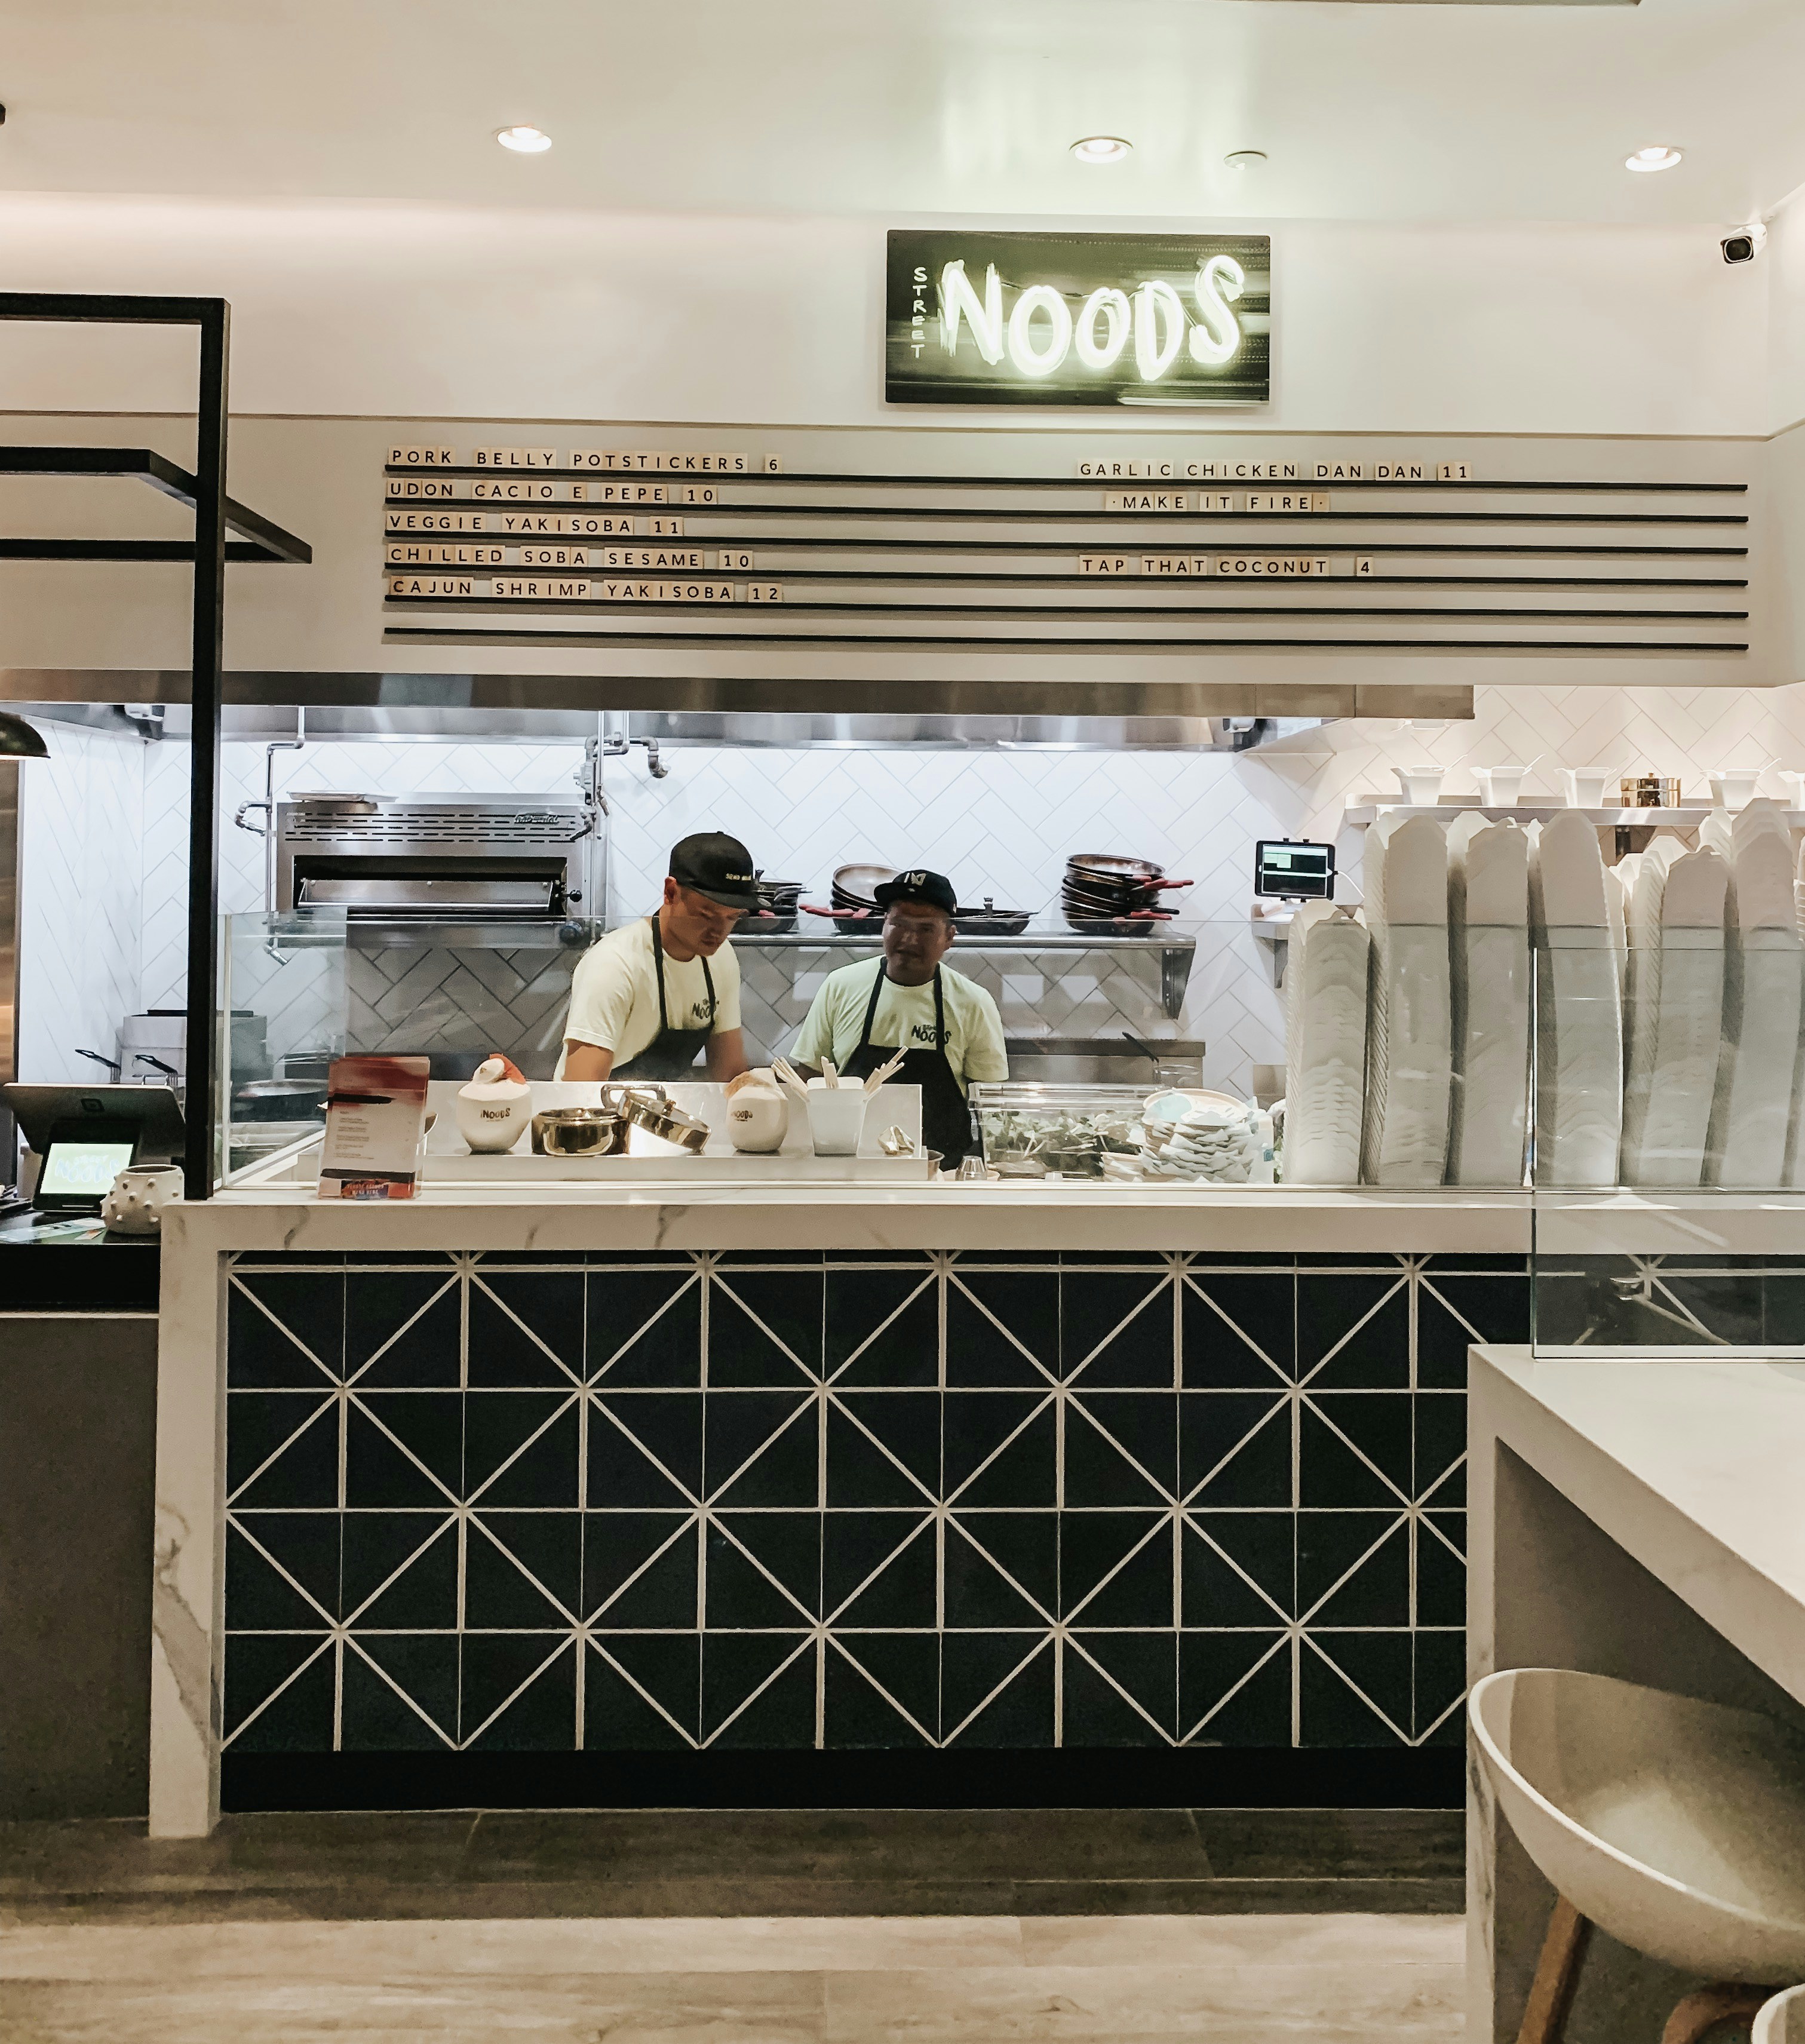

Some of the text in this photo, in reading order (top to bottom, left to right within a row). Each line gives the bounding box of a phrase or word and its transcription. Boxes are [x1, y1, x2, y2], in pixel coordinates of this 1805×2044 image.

[910, 266, 928, 358] STREET
[937, 256, 1244, 380] NOODS
[392, 450, 777, 471] PORK BELLY POTSTICKERS 6
[1080, 464, 1466, 478] GARLIC CHICKEN DAN DAN 11
[391, 482, 713, 502] UDON CACIO E PEPE 10
[1206, 496, 1230, 509] IT
[389, 515, 678, 534] VEGGIE YAKISOBA 11
[391, 548, 749, 567] CHILLED SOBA SESAME 10
[1082, 559, 1370, 573] TAP THAT COCONUT 4
[392, 580, 778, 600] CAJUN SHRIMP YAKISOBA 12
[692, 1003, 716, 1020] NOO
[911, 1025, 952, 1045] NOOS
